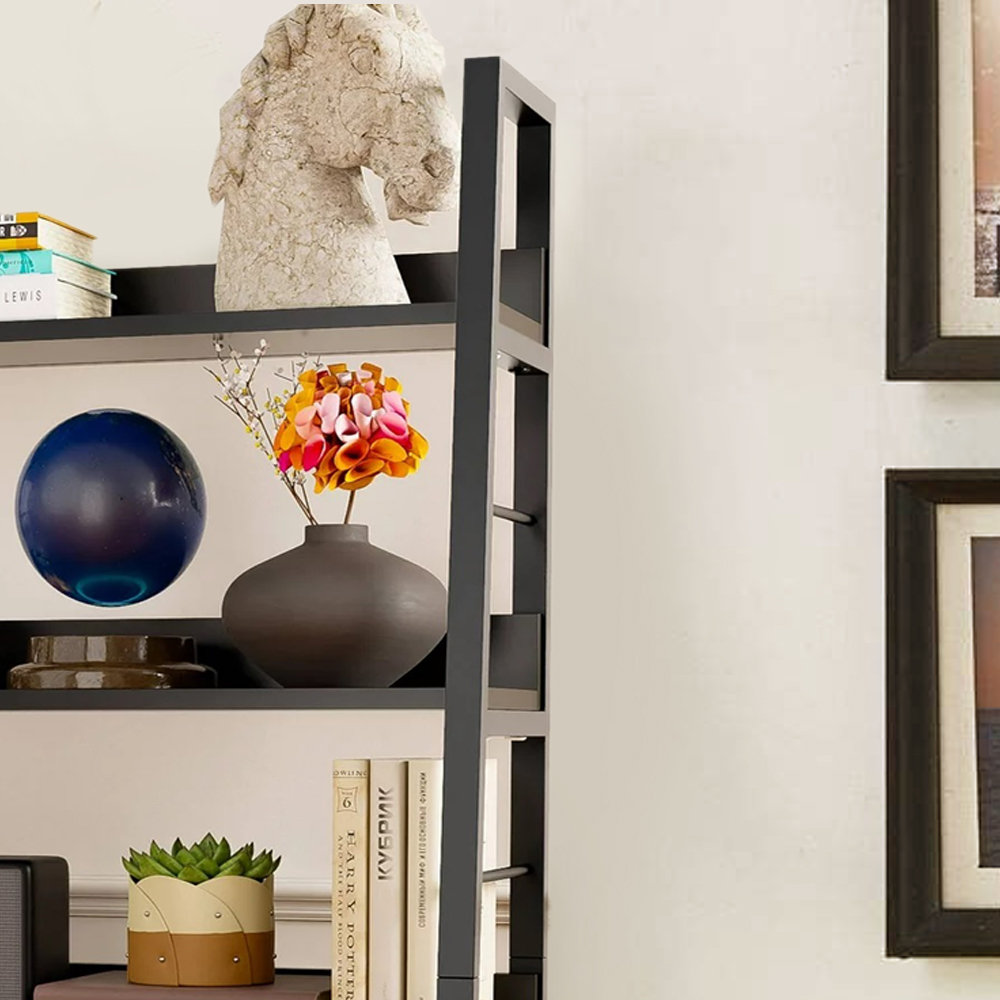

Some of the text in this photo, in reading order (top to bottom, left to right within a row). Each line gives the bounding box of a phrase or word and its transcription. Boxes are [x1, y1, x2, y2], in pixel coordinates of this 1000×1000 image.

[4, 289, 42, 303] LEWIS
[342, 796, 352, 808] 6
[378, 787, 393, 880] КУБРИК
[345, 831, 356, 916] HARRY
